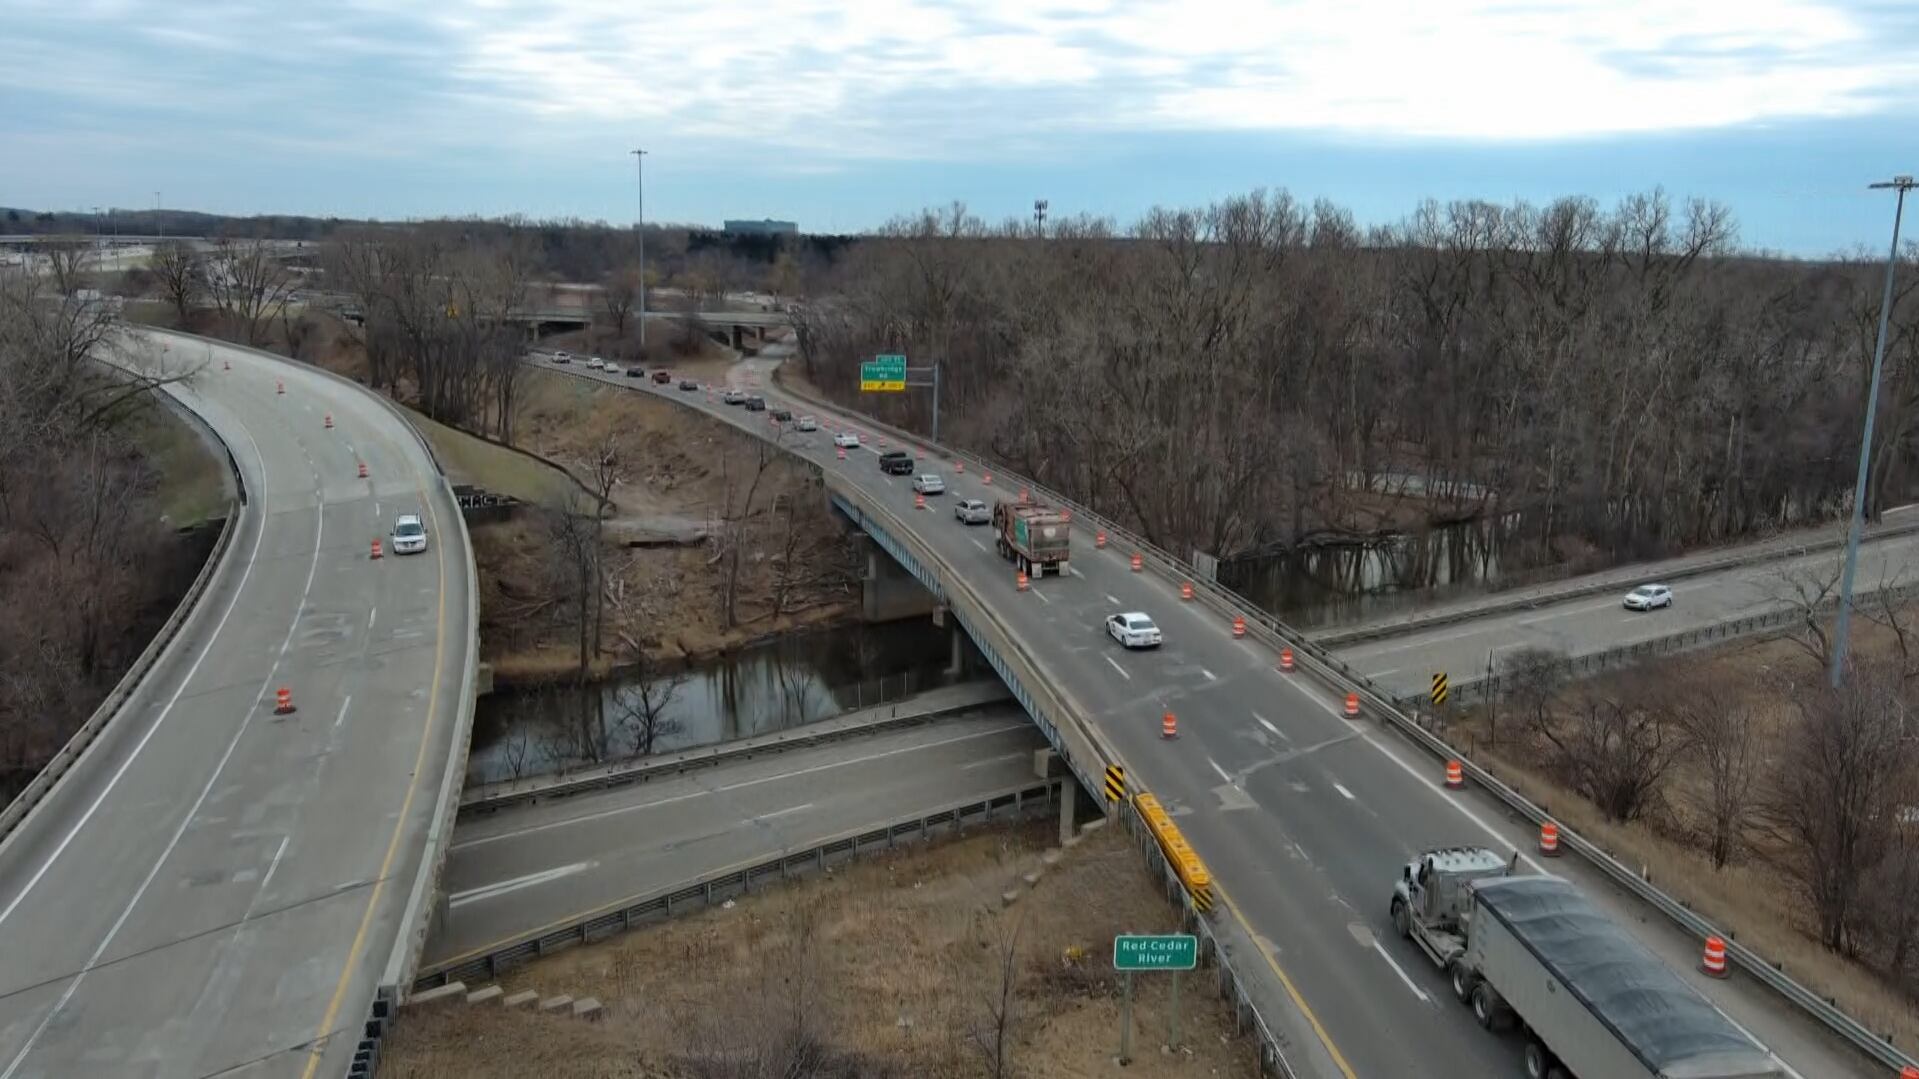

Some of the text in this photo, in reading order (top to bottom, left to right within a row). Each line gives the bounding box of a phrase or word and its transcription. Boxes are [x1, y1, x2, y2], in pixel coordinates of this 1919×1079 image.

[1122, 941, 1188, 951] Red Cedar
[1138, 953, 1172, 963] River
